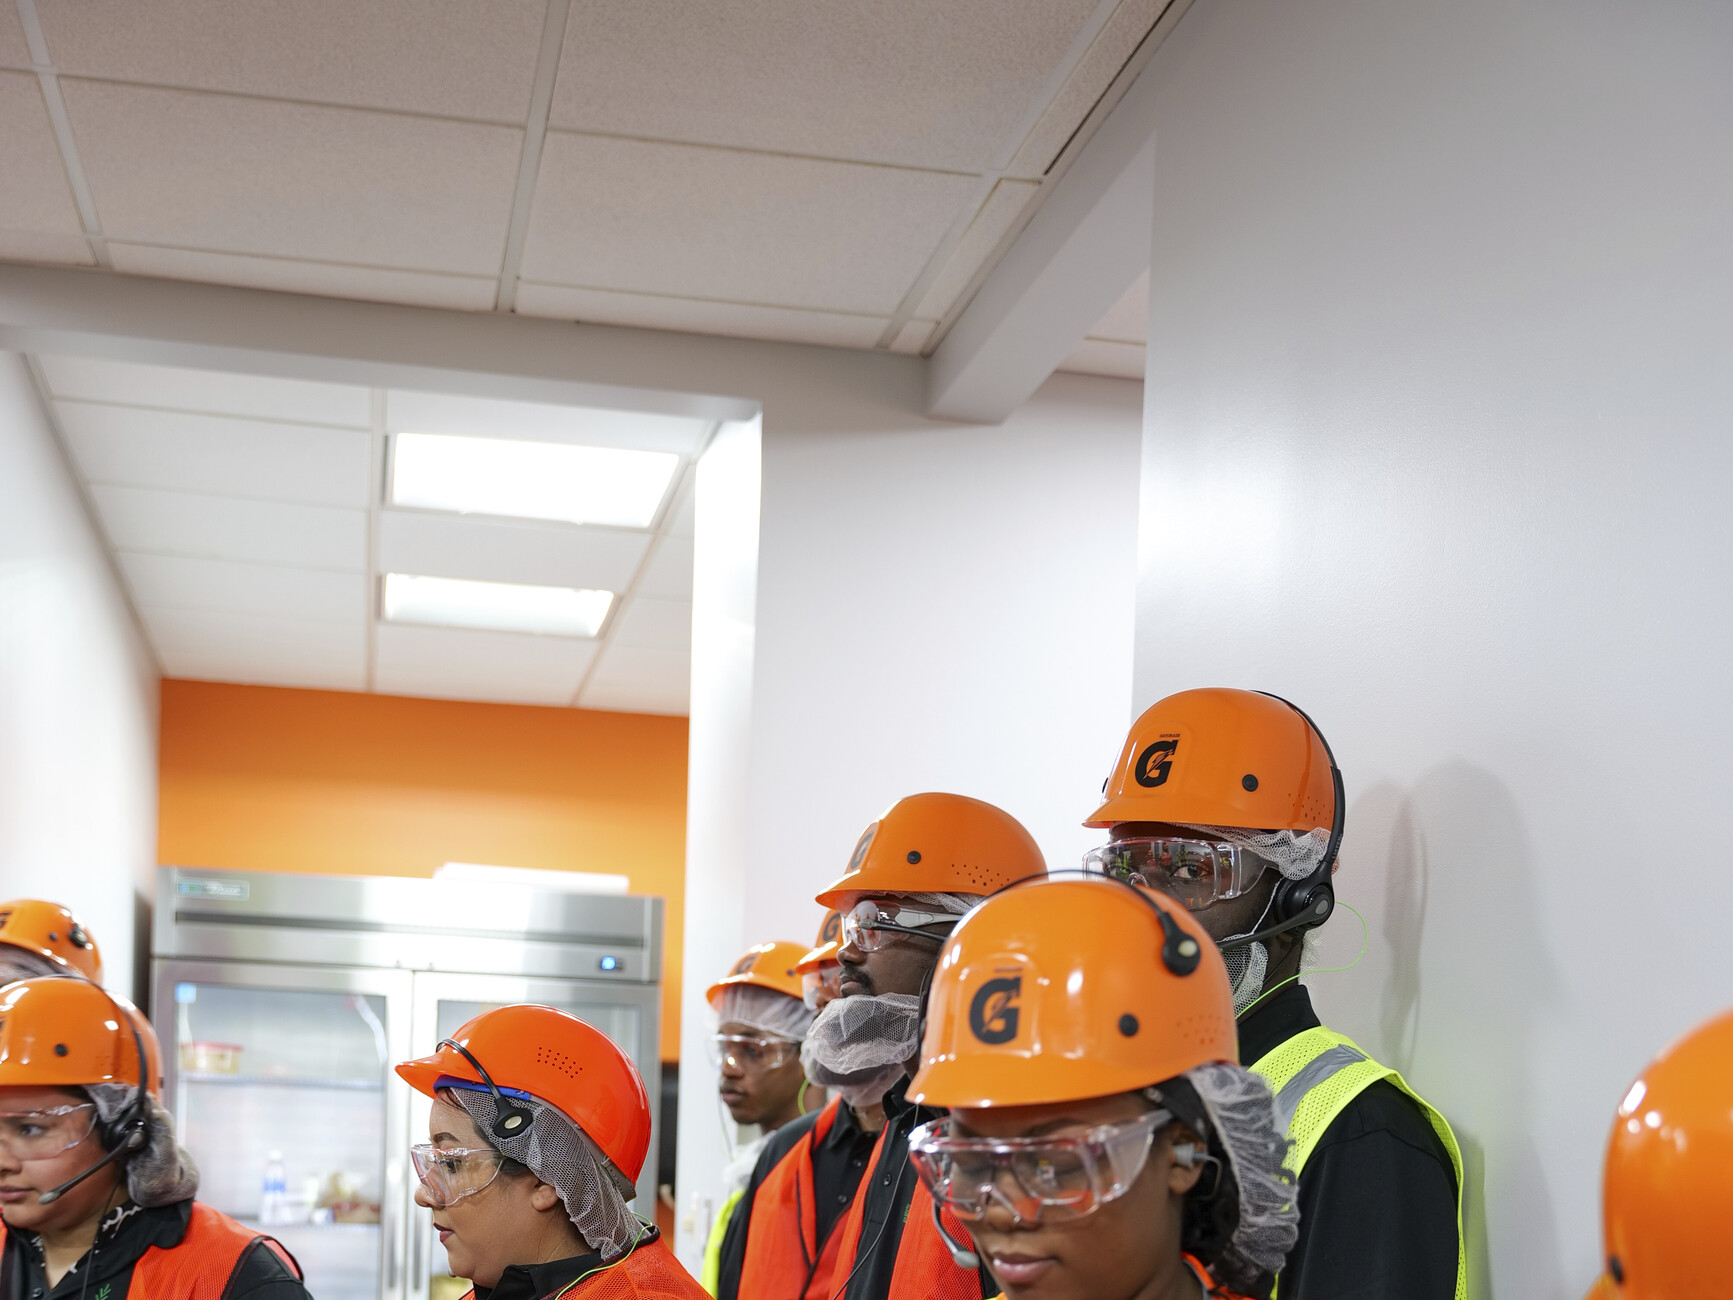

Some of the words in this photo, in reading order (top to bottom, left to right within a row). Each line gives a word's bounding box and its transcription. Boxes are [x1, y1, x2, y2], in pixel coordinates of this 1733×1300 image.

[1135, 740, 1179, 788] G
[850, 832, 874, 870] G
[969, 975, 1022, 1046] G
